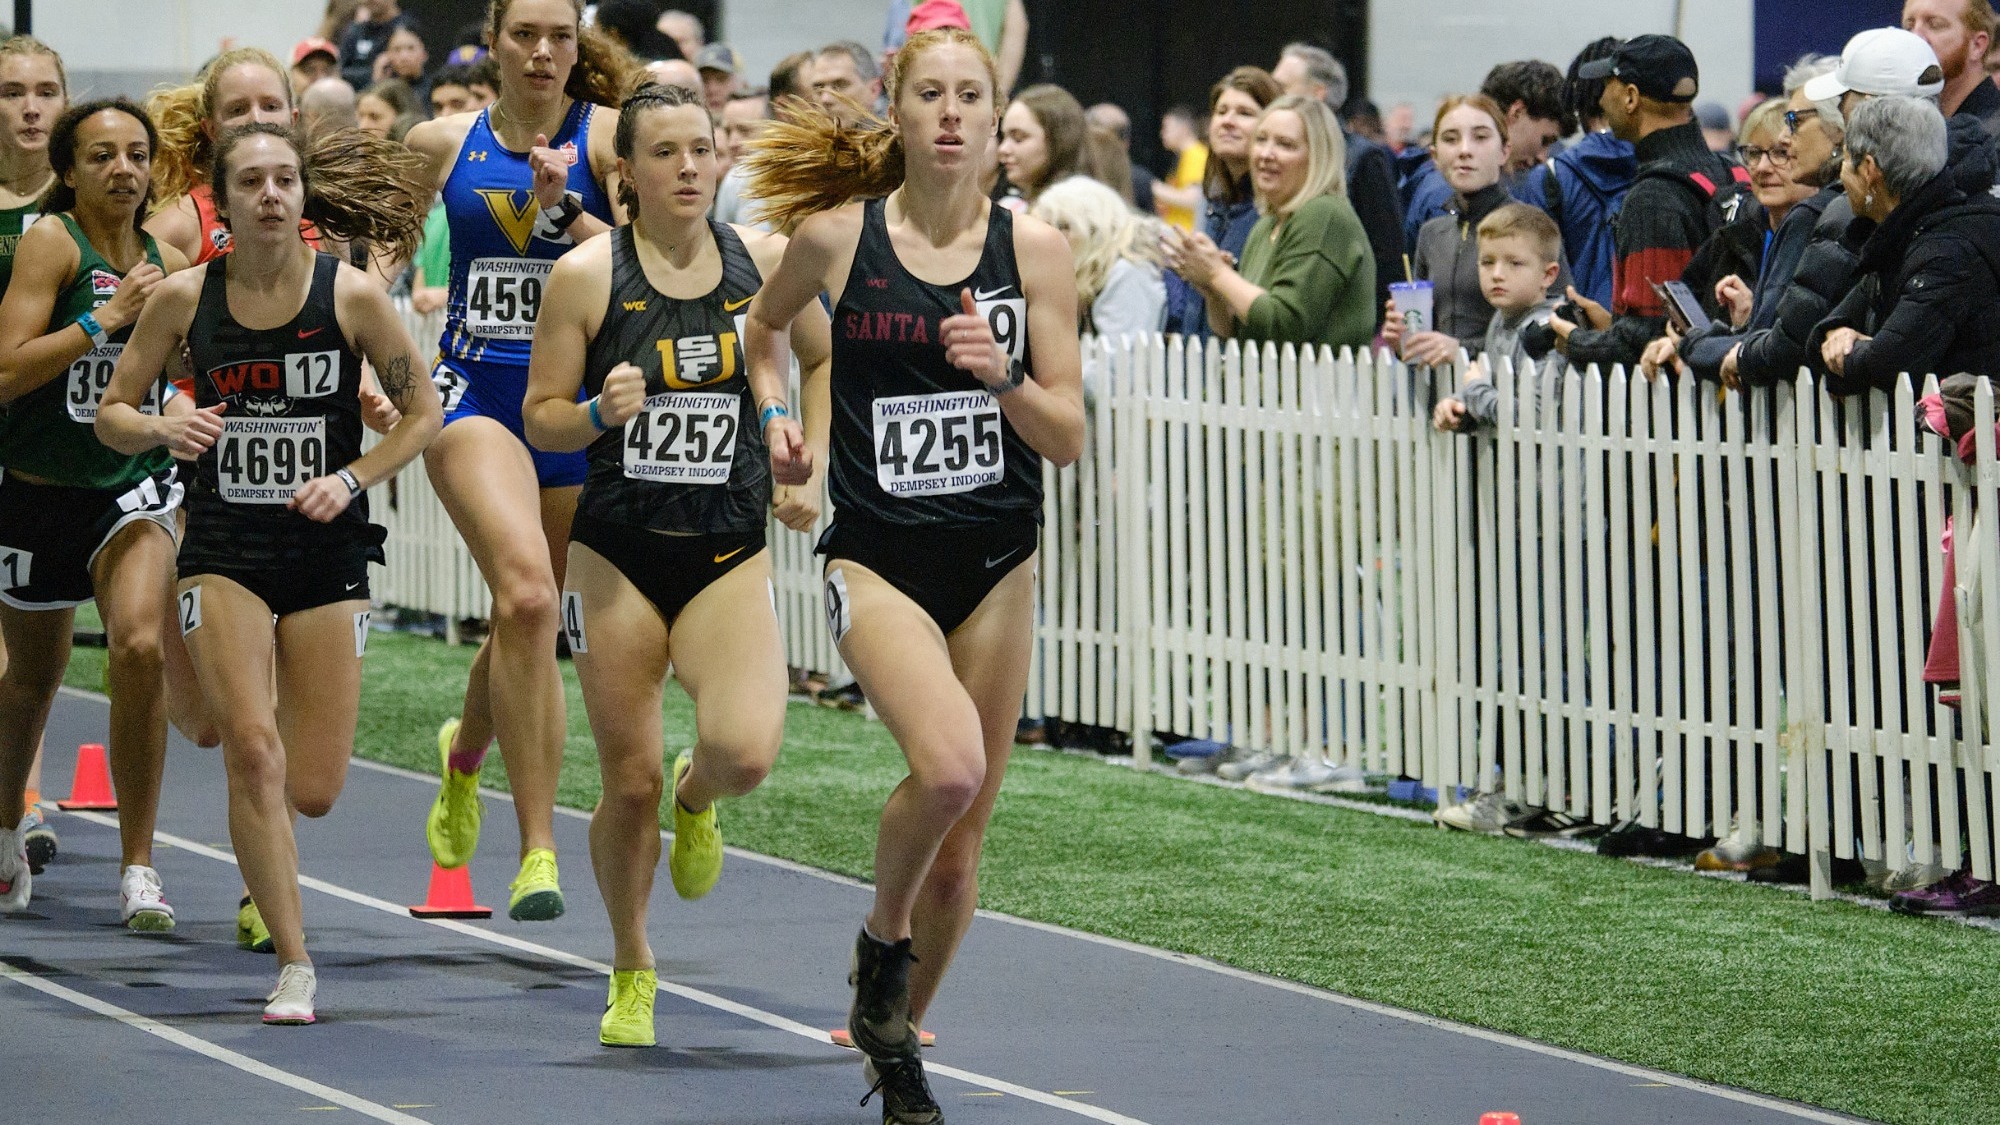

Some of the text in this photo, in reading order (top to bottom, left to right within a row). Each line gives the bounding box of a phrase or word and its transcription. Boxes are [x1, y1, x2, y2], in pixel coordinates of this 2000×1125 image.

[476, 262, 554, 274] WASHINGTO
[470, 277, 542, 321] 459
[623, 300, 647, 311] WCC
[476, 326, 522, 335] DEMPSEY
[846, 311, 929, 344] SANTA
[988, 304, 1017, 355] 9
[211, 362, 280, 396] WO
[296, 354, 332, 395] 12
[881, 395, 990, 416] WASHINGTON
[224, 421, 318, 434] WASHINGTON
[627, 412, 736, 463] 4252
[880, 412, 1000, 476] 4255
[220, 437, 323, 485] 4699
[633, 464, 727, 478] DEMPSEY INDOOR
[227, 488, 275, 498] DEMPSEY
[890, 472, 998, 493] DEMPSEY INDOOR
[566, 595, 582, 649] 4
